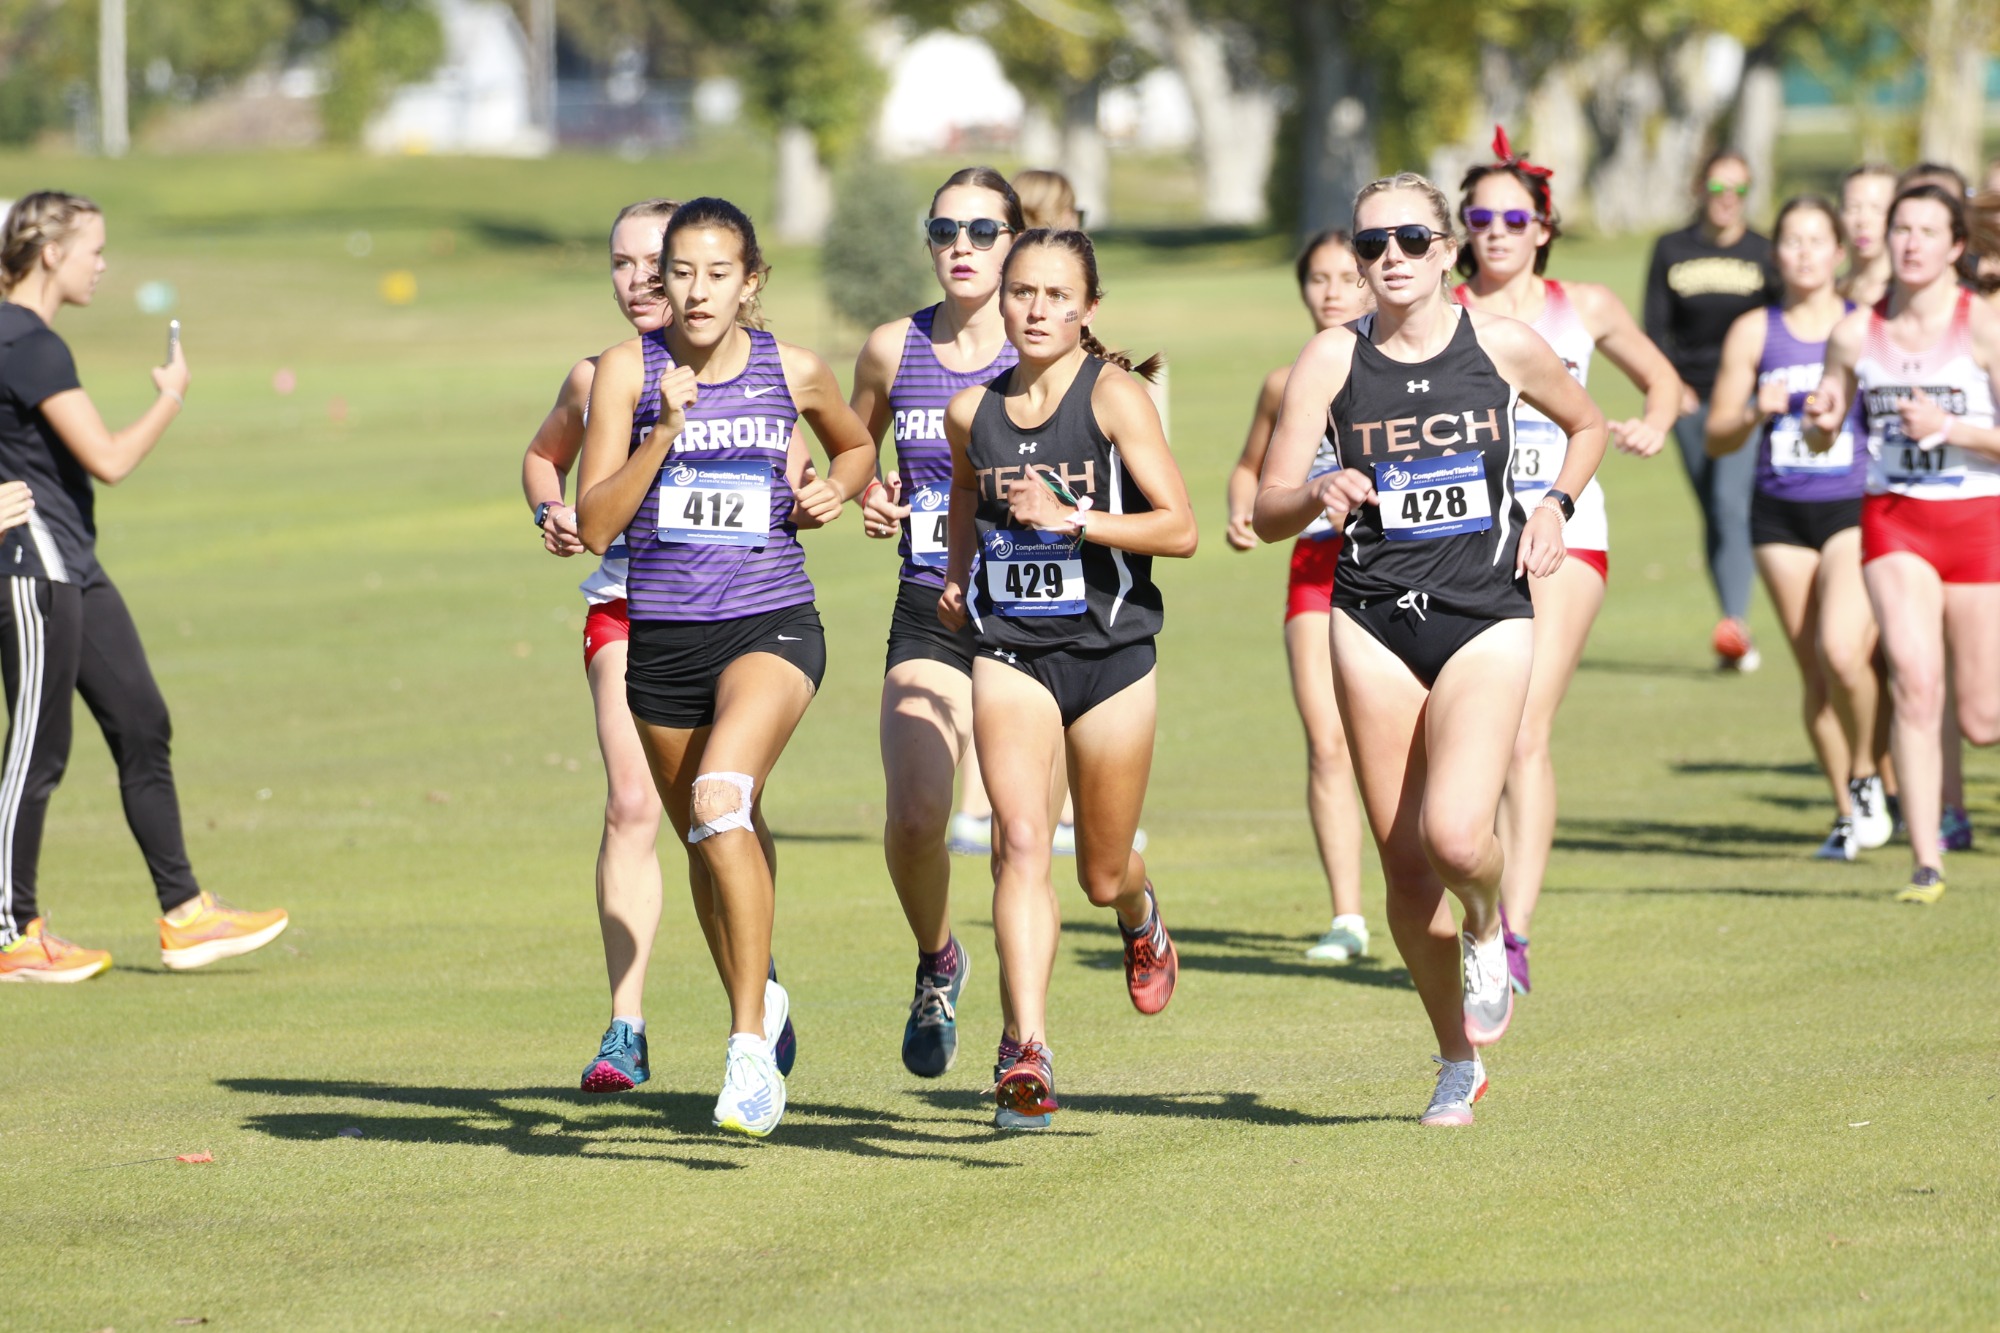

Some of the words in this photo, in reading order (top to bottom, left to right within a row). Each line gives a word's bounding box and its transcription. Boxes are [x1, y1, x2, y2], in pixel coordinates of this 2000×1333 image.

[1352, 408, 1501, 456] TECH
[683, 491, 744, 528] 412
[1402, 486, 1467, 523] 428
[1006, 563, 1063, 598] 429
